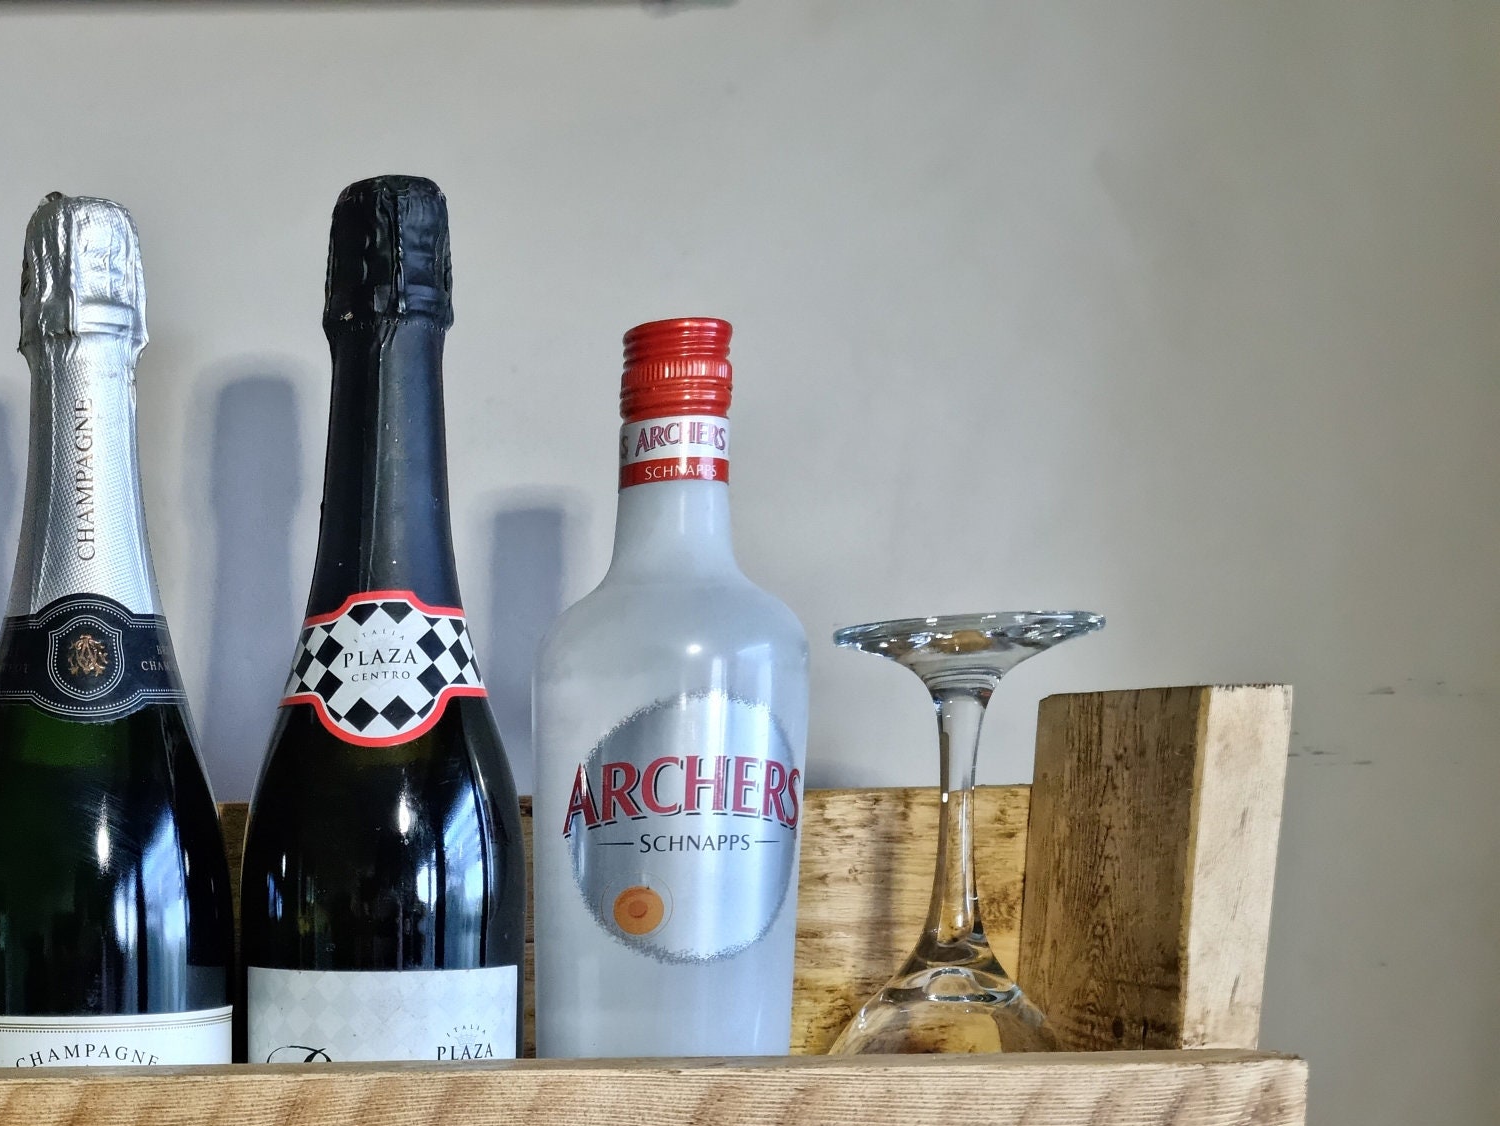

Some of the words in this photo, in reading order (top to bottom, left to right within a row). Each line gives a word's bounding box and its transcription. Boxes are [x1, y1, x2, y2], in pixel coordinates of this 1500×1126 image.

[635, 421, 726, 457] ARCHERS
[75, 398, 96, 561] CHAMPAGNE
[645, 464, 717, 481] SCHNAPPS
[353, 628, 405, 643] ITALIA
[343, 648, 418, 668] PLAZA
[351, 670, 411, 682] CENTRO
[562, 755, 801, 838] ARCHERS
[639, 833, 750, 853] SCHNAPPS
[16, 1043, 159, 1067] CHAMPAGNE
[437, 1043, 494, 1060] PLAZA
